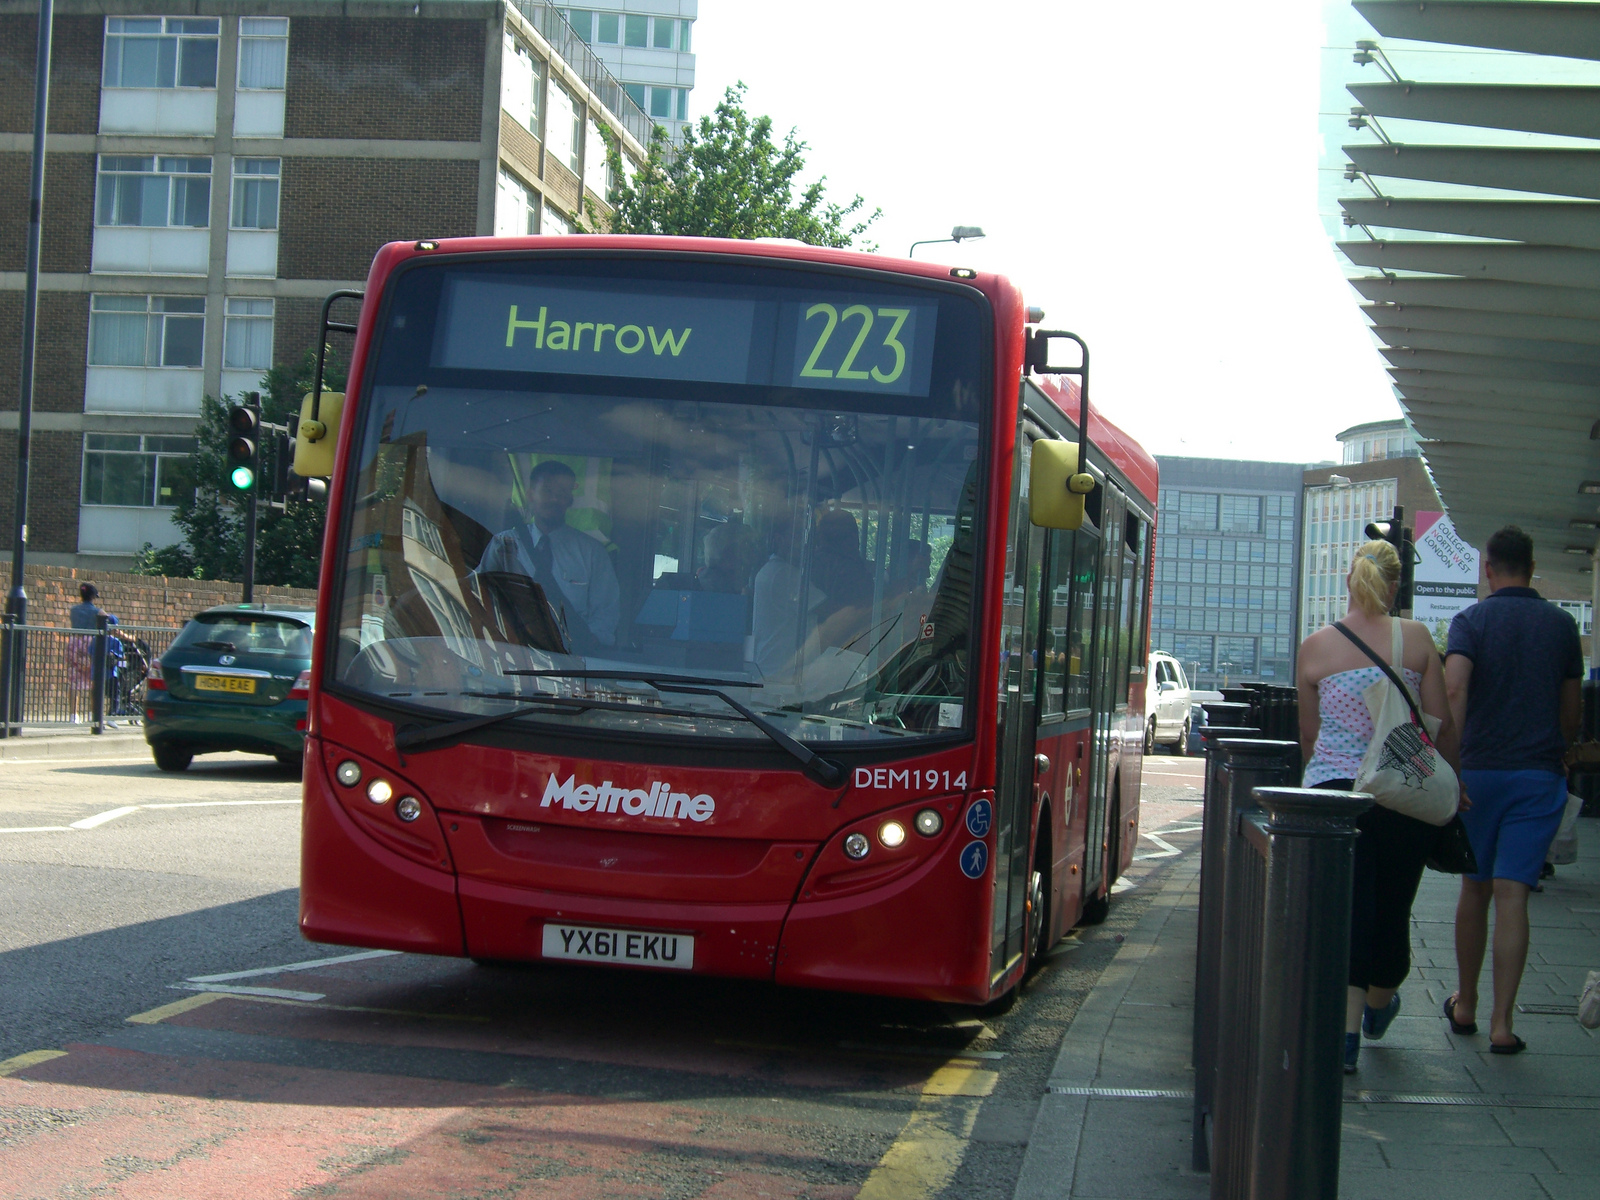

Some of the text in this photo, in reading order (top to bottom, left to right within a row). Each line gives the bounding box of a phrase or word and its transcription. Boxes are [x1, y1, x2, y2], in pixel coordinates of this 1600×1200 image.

[505, 304, 692, 358] Harrow
[799, 302, 910, 384] 223
[1424, 535, 1453, 569] LONDON
[1431, 529, 1472, 574] NORTH WEST
[1438, 523, 1475, 563] COLLEGE OF
[1416, 585, 1476, 596] Open to the public
[1430, 603, 1460, 611] Restaurant
[230, 681, 250, 692] EAE
[855, 767, 968, 791] DEM1914
[540, 773, 715, 822] Metroline
[506, 824, 540, 833] SCREENWASH
[560, 928, 678, 962] YX61 EKU
